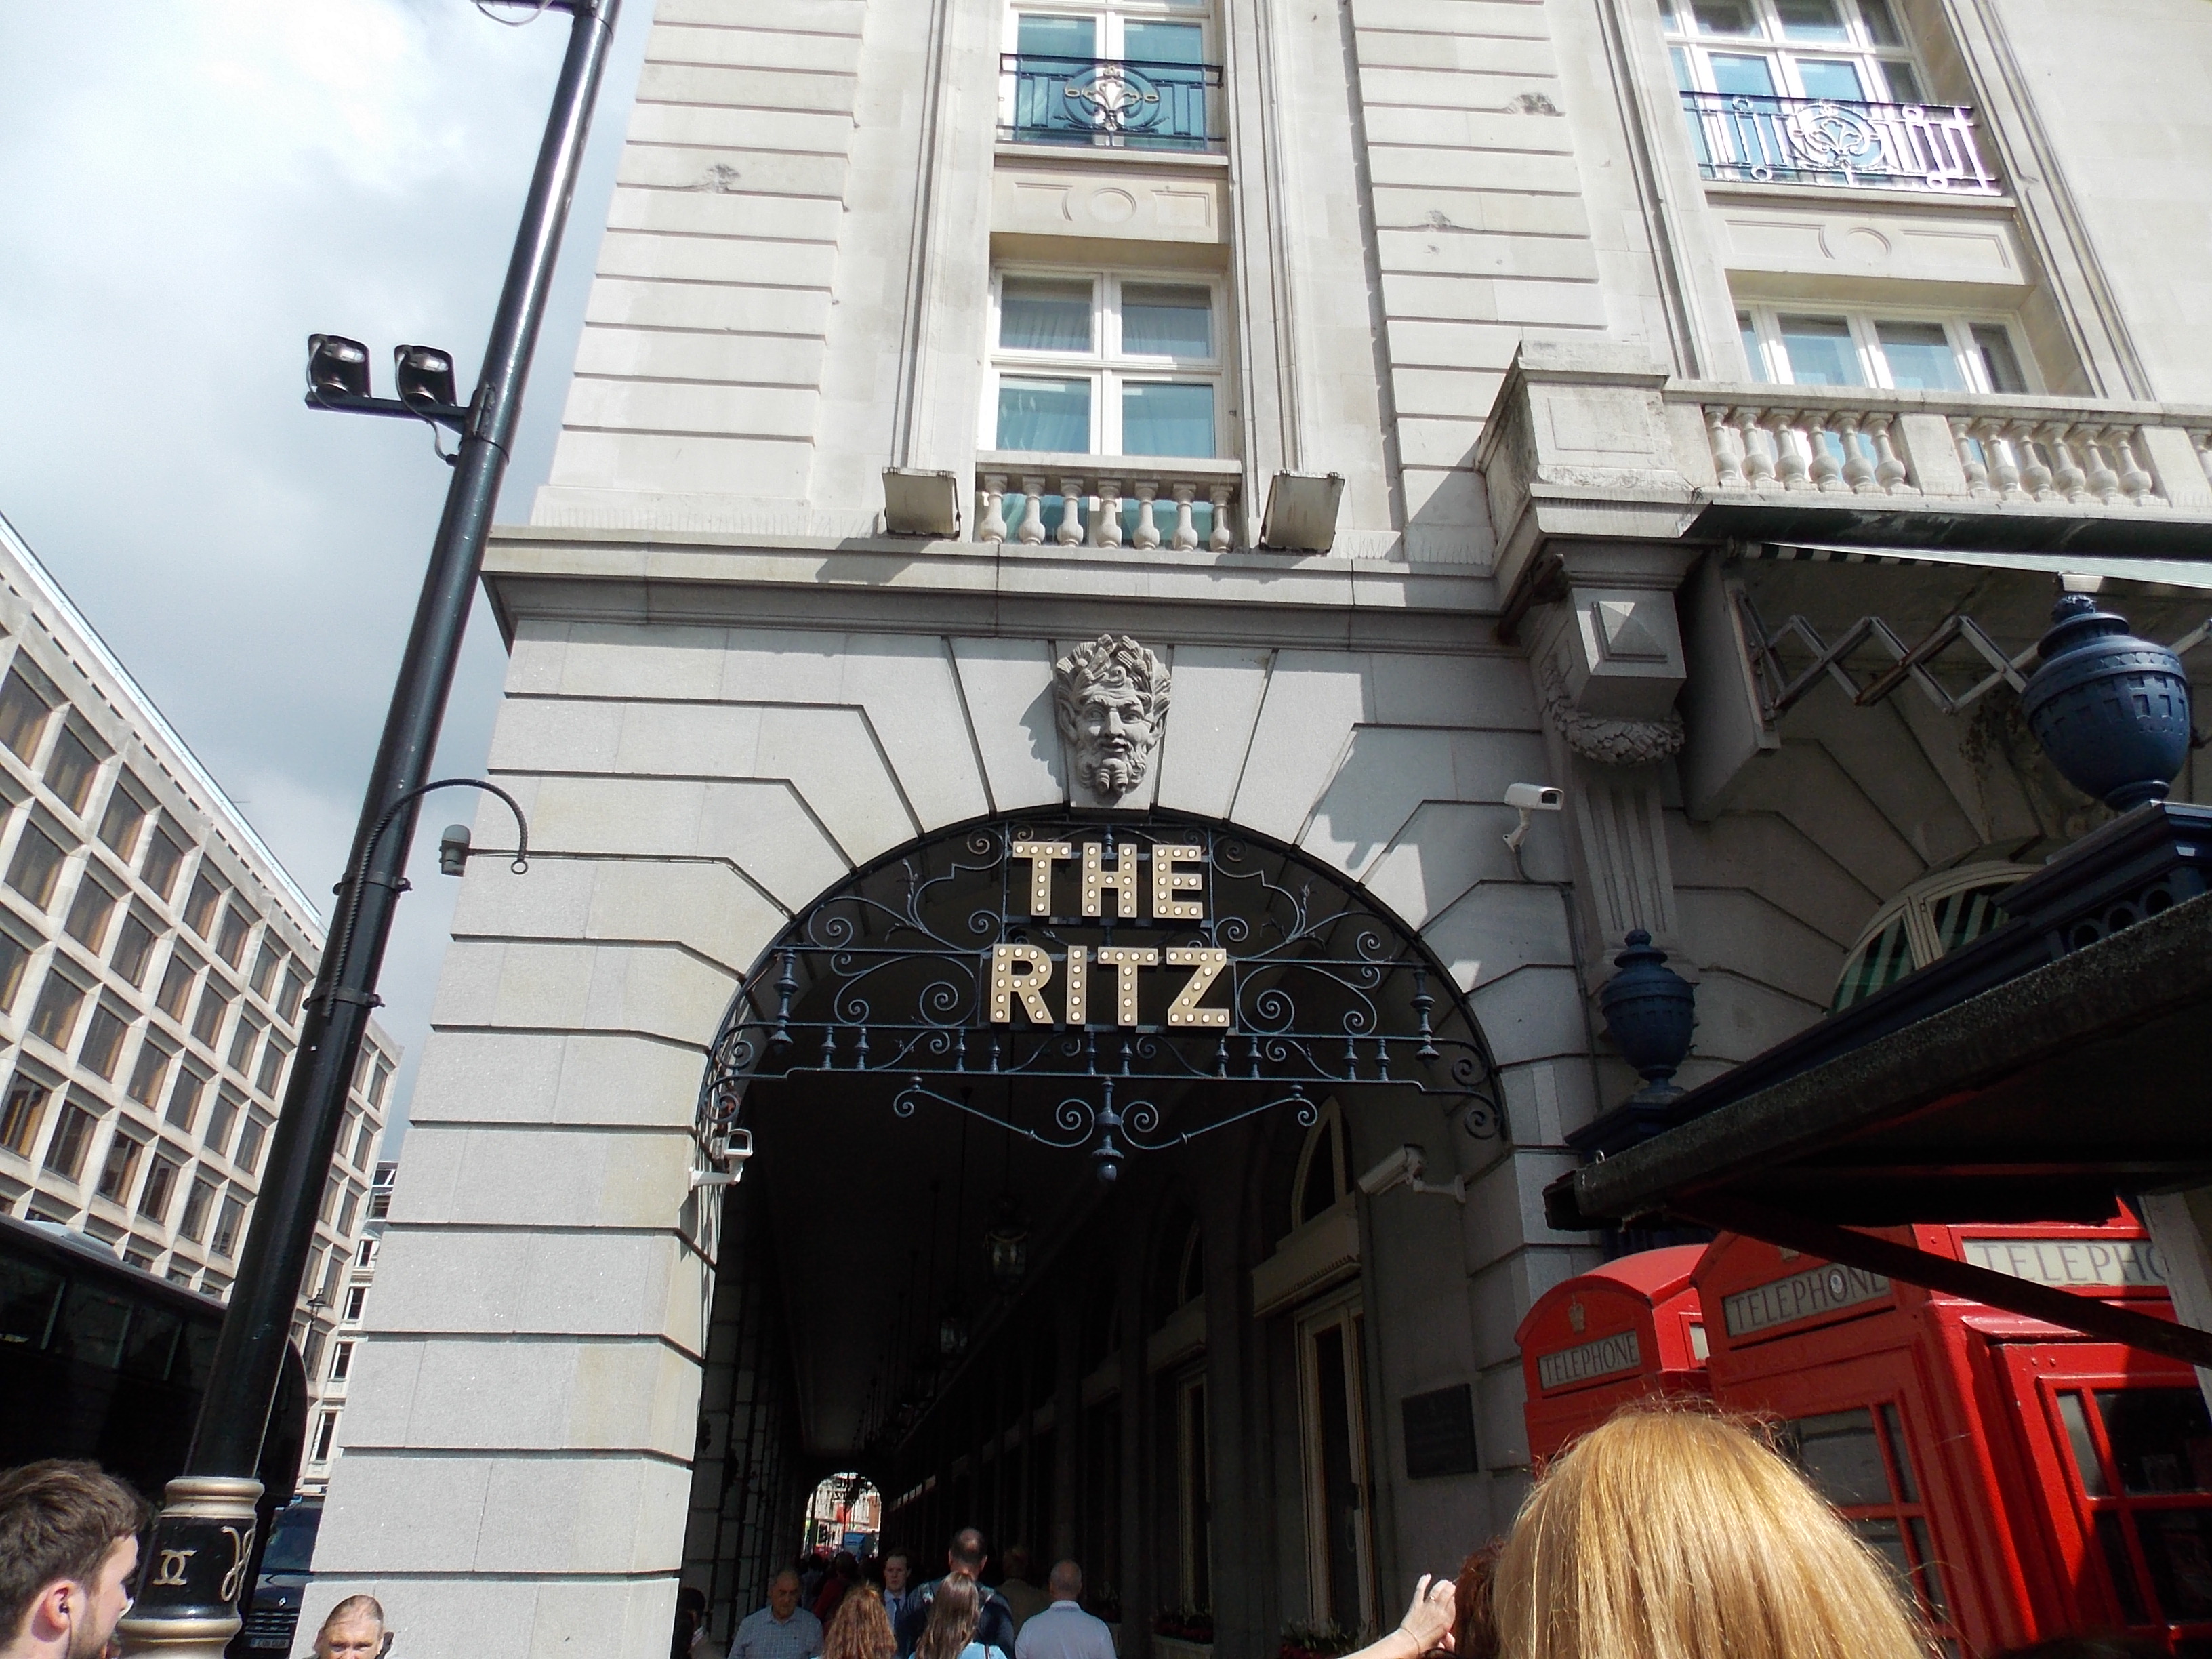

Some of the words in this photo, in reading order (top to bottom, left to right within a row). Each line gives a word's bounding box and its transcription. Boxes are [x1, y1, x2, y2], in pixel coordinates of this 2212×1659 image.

[1012, 841, 1203, 919] THE
[990, 944, 1230, 1027] RITZ
[1543, 1334, 1639, 1384] TELEPHONE
